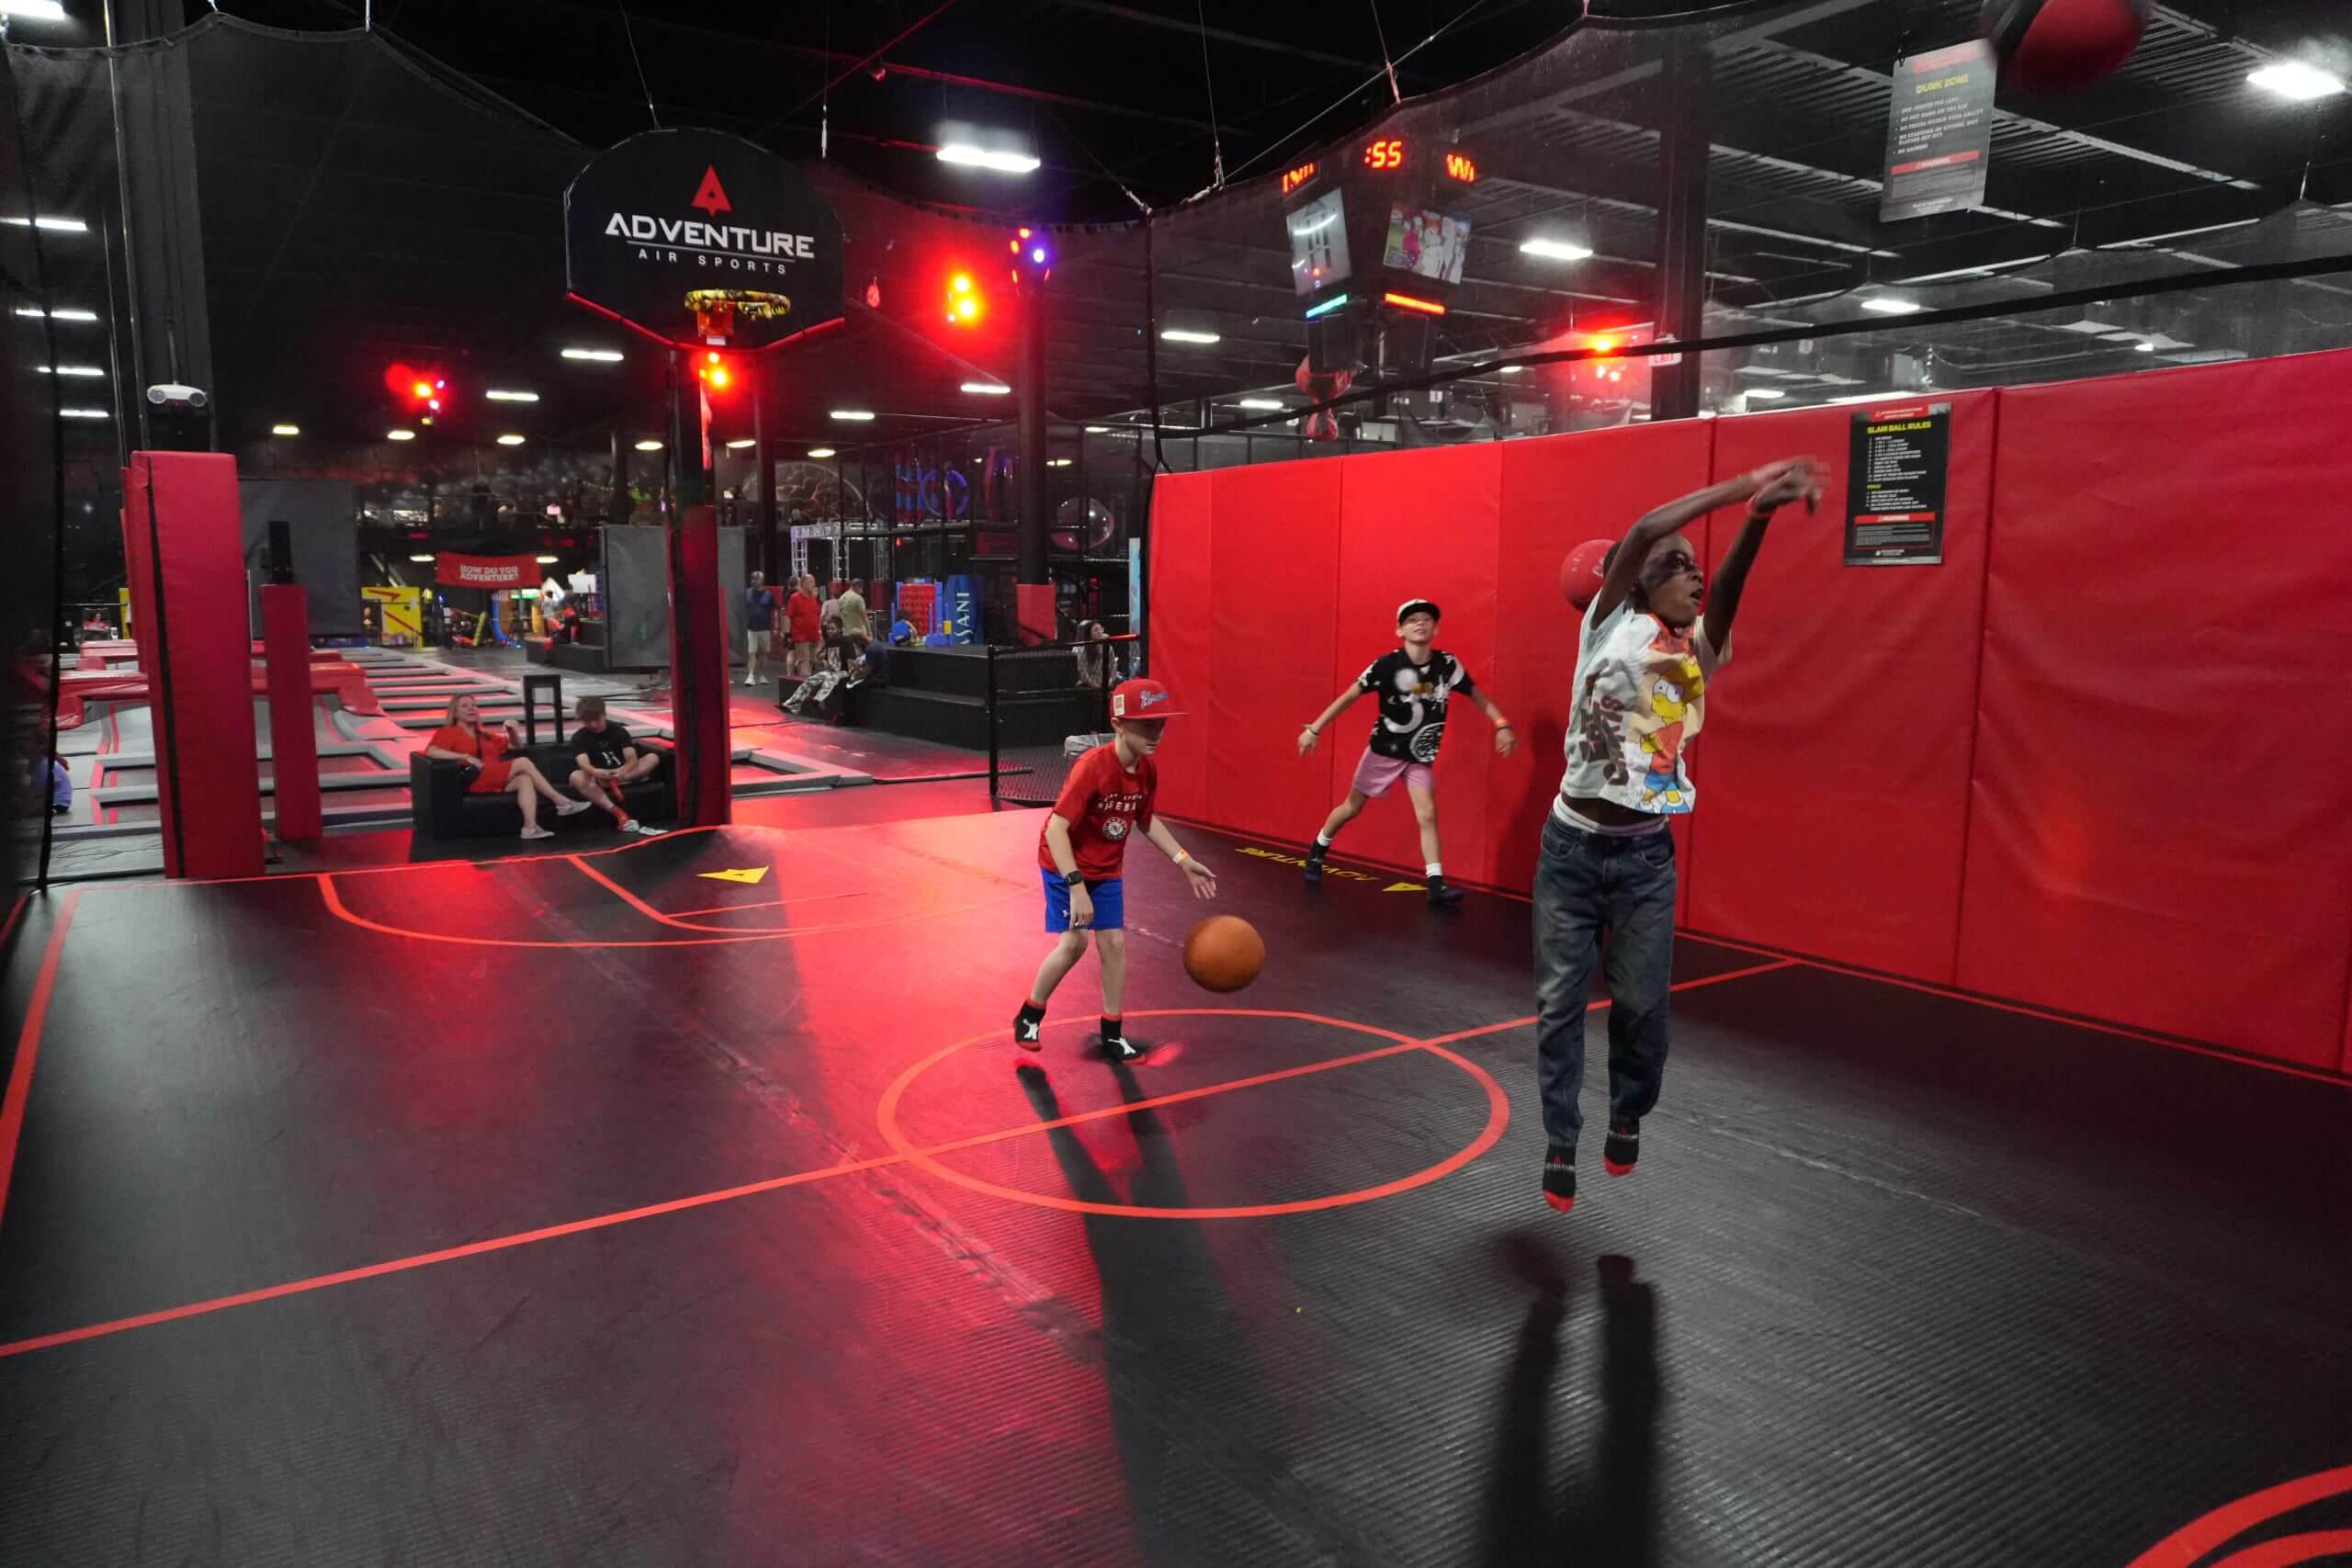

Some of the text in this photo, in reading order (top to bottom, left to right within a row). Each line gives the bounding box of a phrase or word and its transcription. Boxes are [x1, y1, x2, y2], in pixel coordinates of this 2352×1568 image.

[1916, 83, 1942, 94] DUNK
[605, 212, 815, 258] ADVENTURE
[639, 249, 786, 275] AIR SPORTS
[1867, 421, 1931, 434] SLAM BALL RULES
[460, 565, 481, 573] HOW
[460, 573, 519, 581] ADVENTURE?
